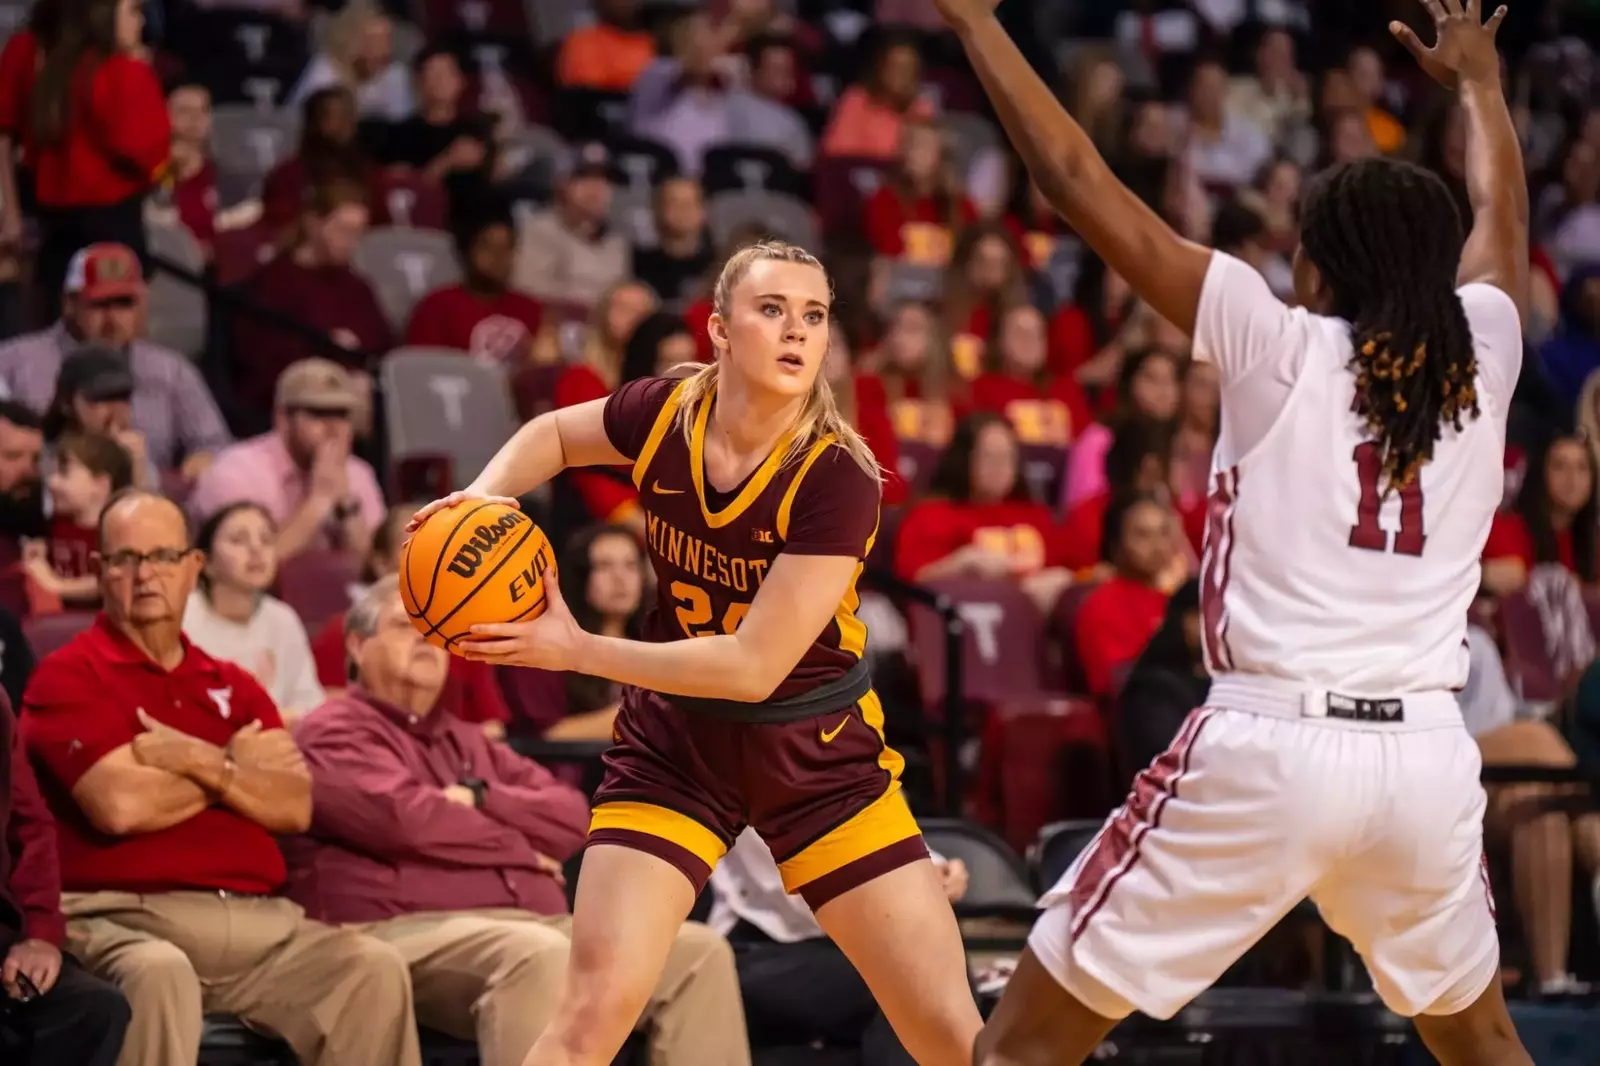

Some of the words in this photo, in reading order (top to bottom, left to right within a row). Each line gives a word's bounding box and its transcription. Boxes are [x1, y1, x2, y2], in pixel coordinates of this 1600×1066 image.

[1348, 440, 1428, 558] 11
[446, 512, 526, 578] Wilson
[509, 548, 548, 603] EVO
[646, 509, 768, 592] MINNESOT
[670, 580, 751, 638] 2
